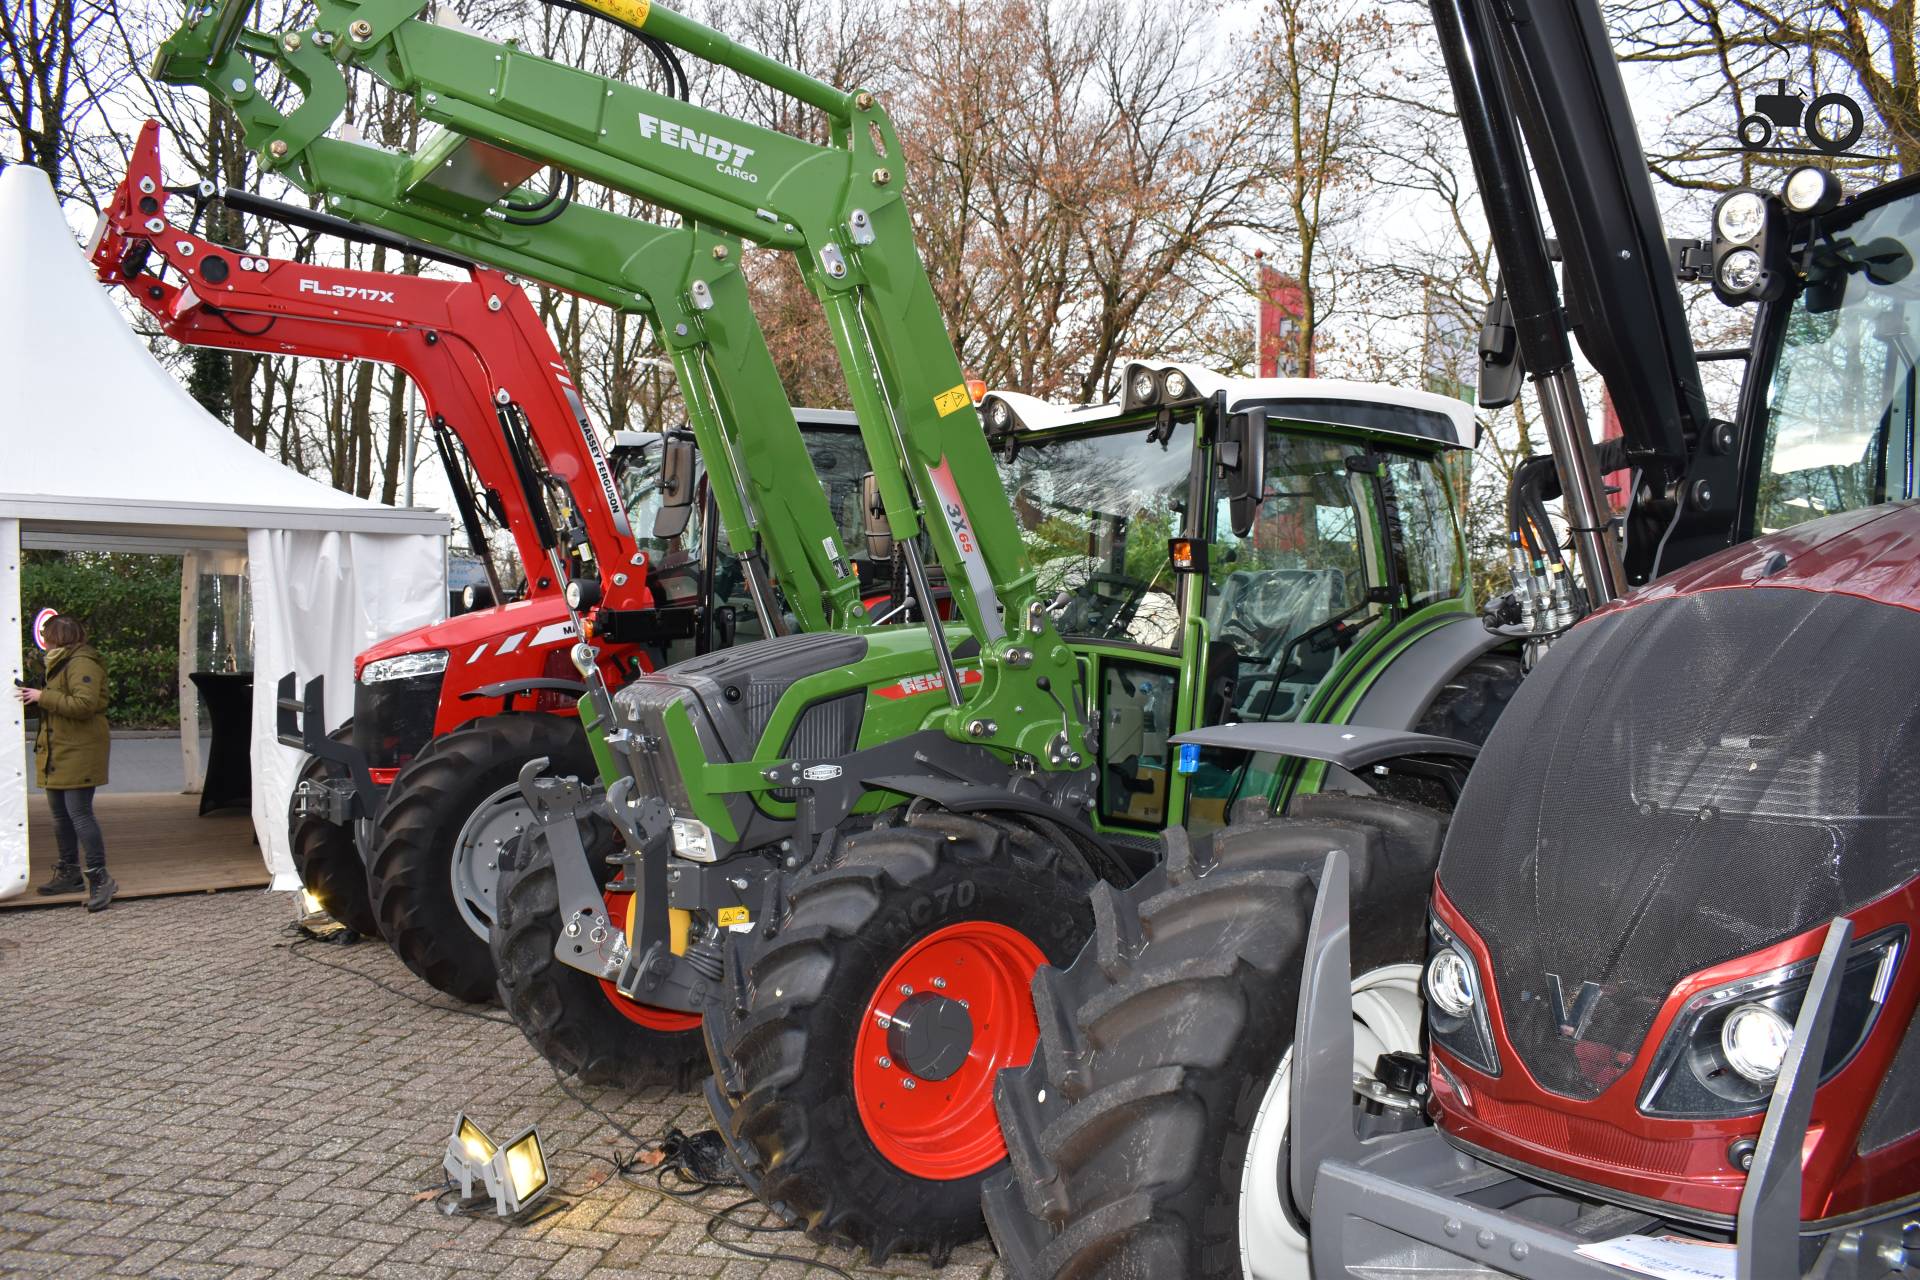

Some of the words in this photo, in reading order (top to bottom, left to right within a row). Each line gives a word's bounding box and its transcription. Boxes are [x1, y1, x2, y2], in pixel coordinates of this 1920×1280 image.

[638, 112, 756, 168] FENDT
[716, 163, 759, 183] CARGO
[299, 278, 395, 304] FL.3717X
[580, 418, 602, 459] MASSEY
[596, 460, 620, 514] FERGUSON
[899, 666, 969, 695] FENT
